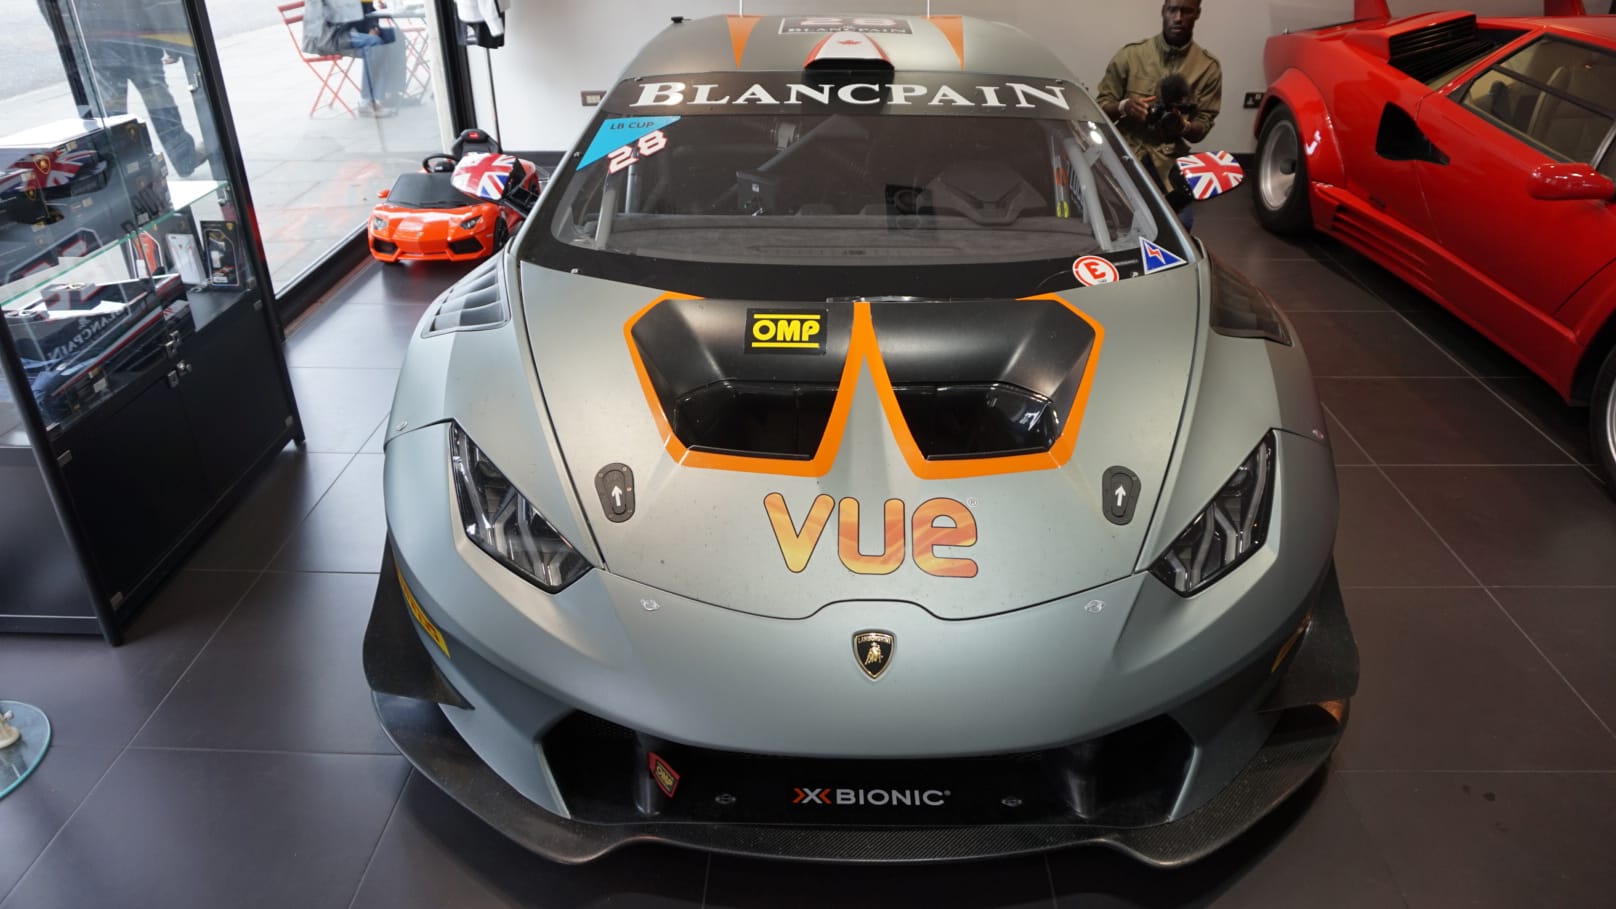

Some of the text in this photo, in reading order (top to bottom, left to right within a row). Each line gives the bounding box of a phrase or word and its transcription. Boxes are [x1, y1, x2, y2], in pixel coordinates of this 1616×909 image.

[629, 81, 1071, 110] BLANCPAIN
[610, 121, 655, 130] LB CUP
[608, 130, 668, 175] 28
[1083, 261, 1107, 280] E
[753, 319, 820, 342] OMP
